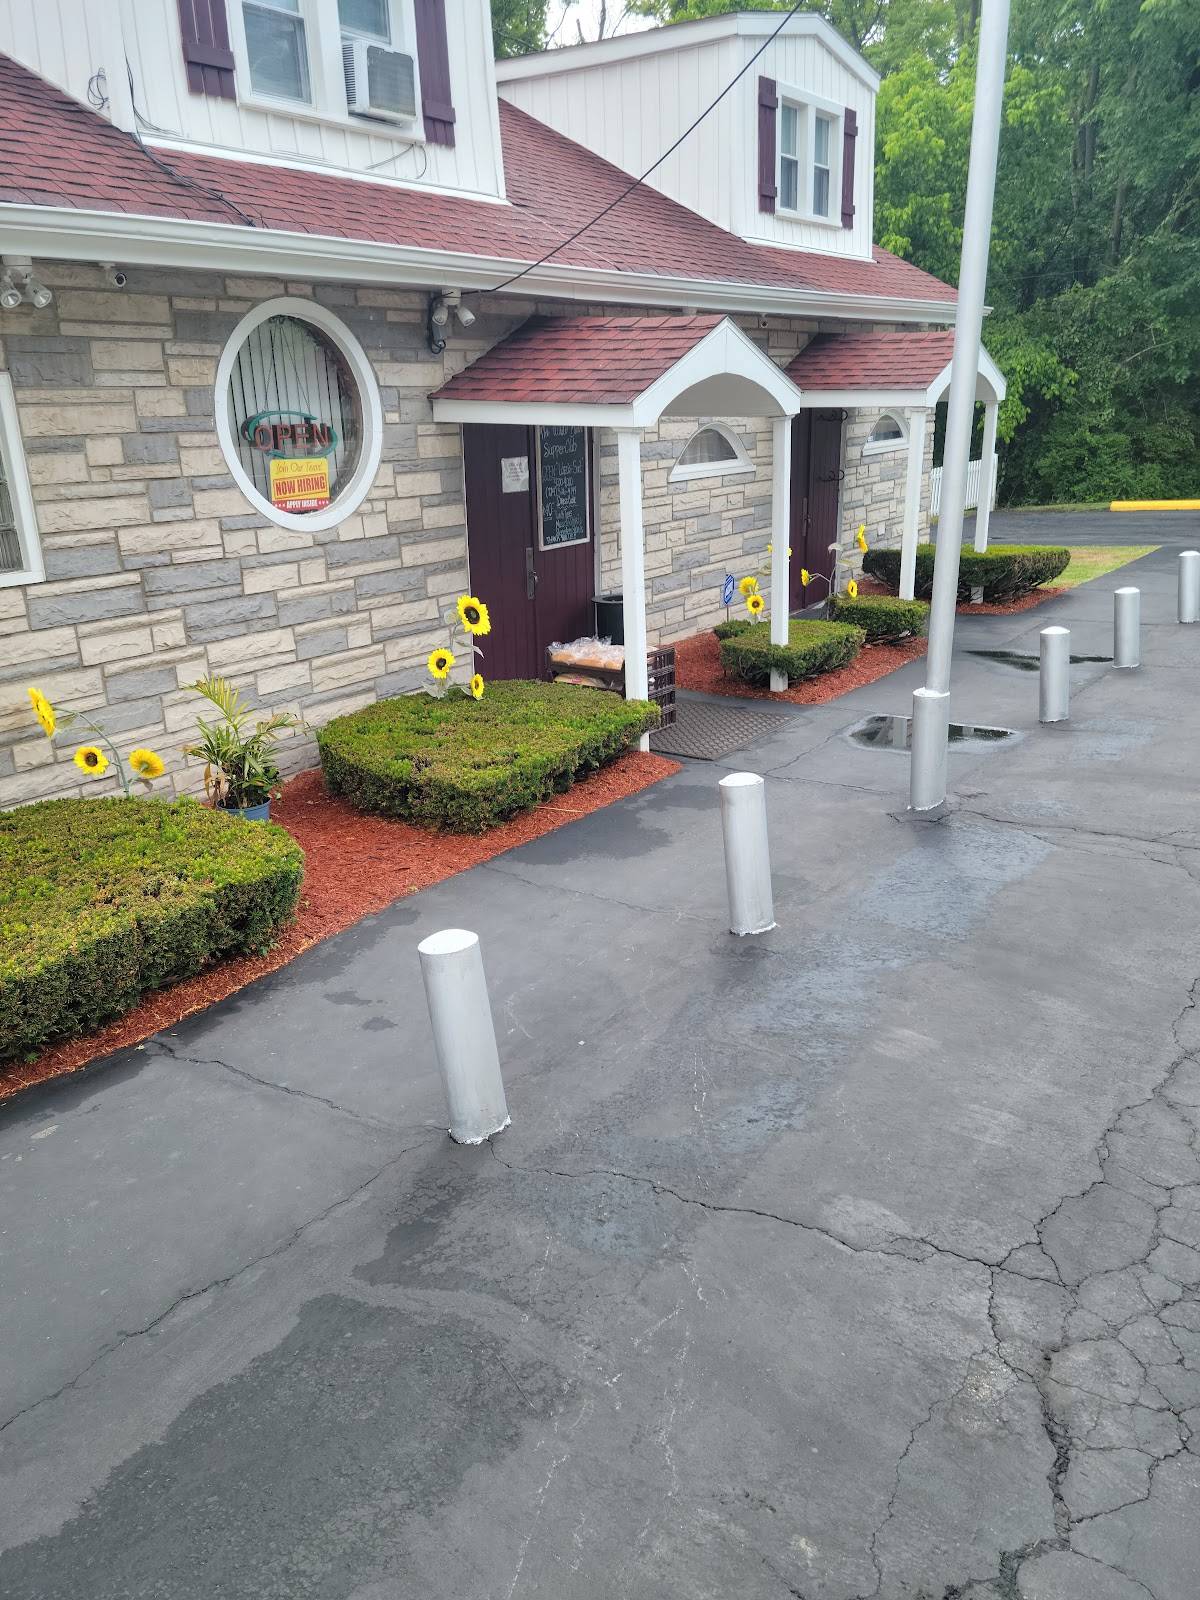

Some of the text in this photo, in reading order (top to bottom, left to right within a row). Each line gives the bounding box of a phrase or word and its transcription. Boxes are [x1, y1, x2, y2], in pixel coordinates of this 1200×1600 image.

[255, 423, 329, 451] OPEN
[276, 463, 289, 474] Join
[290, 462, 303, 472] Our
[275, 477, 326, 496] NOW HIRING
[286, 499, 318, 509] APPLY INSIDE
